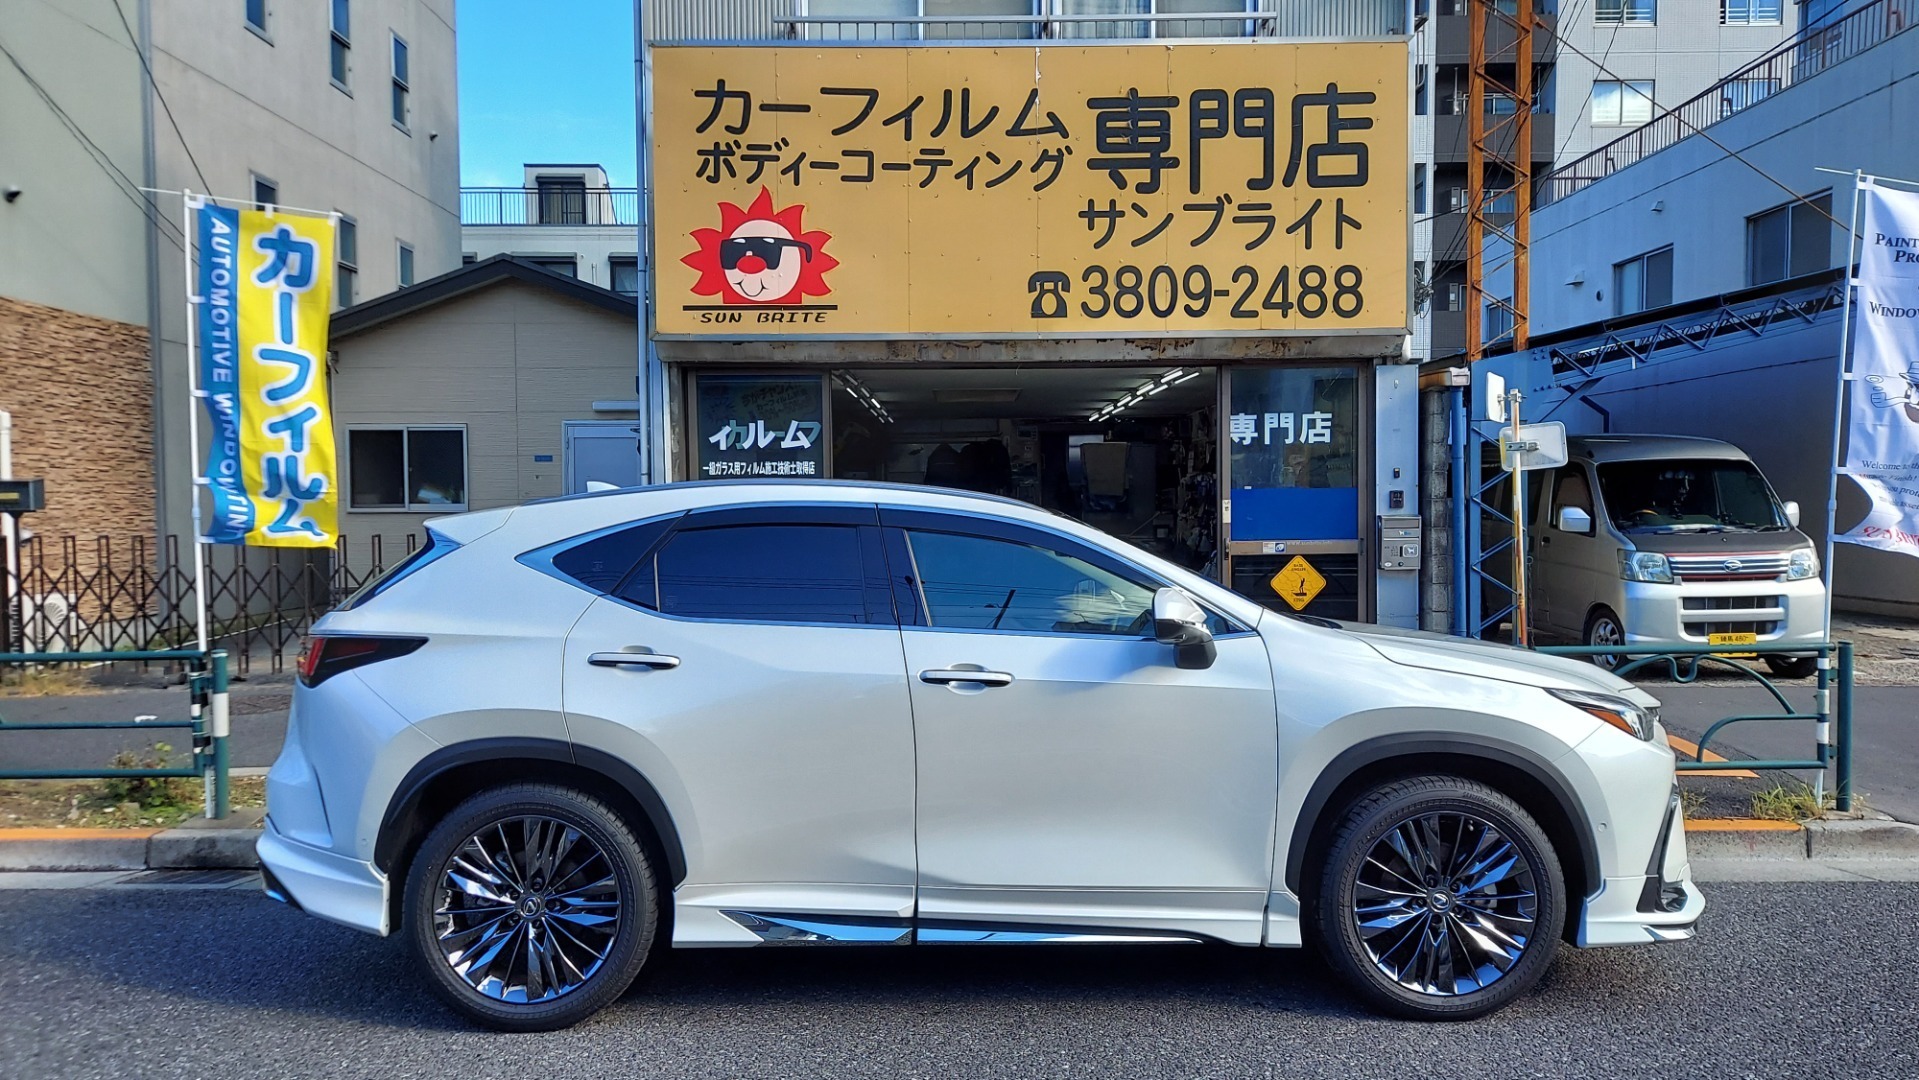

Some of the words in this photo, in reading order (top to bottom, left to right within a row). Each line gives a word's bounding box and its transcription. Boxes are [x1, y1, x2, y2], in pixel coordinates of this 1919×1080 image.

[694, 79, 1071, 142] カーフィルム
[1086, 82, 1378, 194] 専門店
[696, 136, 1074, 192] ボディーコーティング
[1078, 193, 1363, 251] サンブライト
[1875, 233, 1919, 248] PAINT
[210, 217, 232, 382] AUTOMOTIVE
[700, 312, 742, 323] SUN
[756, 312, 828, 323] BRITE
[1080, 264, 1364, 319] 3809-2488
[1869, 301, 1919, 318] WINDO
[254, 226, 328, 539] カーフィルム
[1230, 411, 1333, 445] 専門店
[1862, 460, 1900, 470] Welcome
